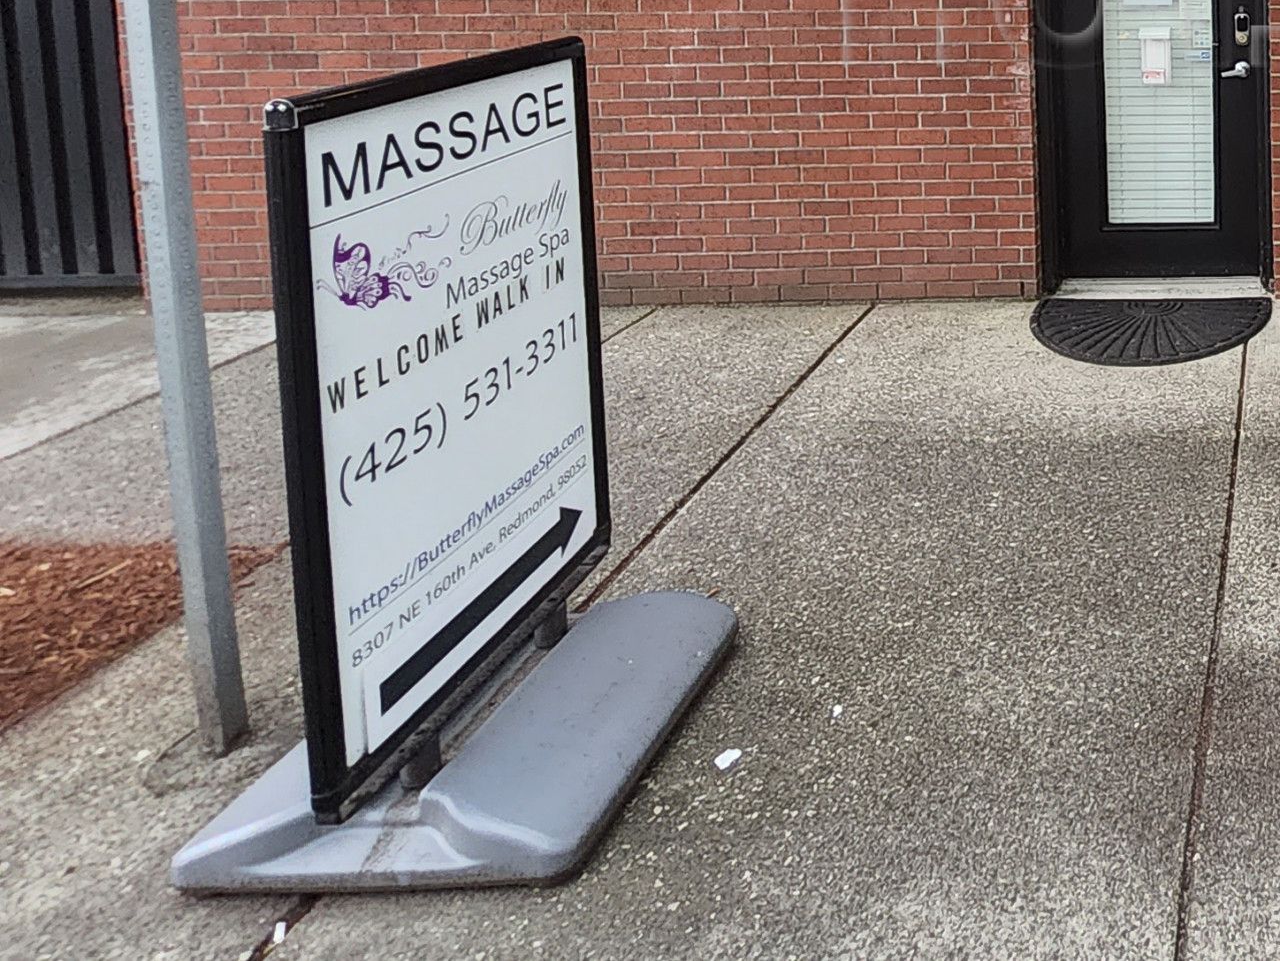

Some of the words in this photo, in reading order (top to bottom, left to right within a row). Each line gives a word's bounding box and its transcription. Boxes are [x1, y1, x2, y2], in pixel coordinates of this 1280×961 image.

[321, 83, 567, 208] MASSAGE
[445, 246, 536, 309] Massage
[539, 228, 571, 263] Spa
[459, 179, 568, 256] Butterfly
[327, 313, 464, 414] WELCOME
[476, 278, 530, 330] WALK
[544, 257, 566, 290] IN
[340, 402, 448, 506] (425)
[463, 312, 579, 421] 531-3311
[347, 423, 586, 626] https://ButterflyMassageSpa.com
[352, 622, 396, 669] 8307
[399, 601, 423, 630] NE
[426, 563, 468, 609] 160th
